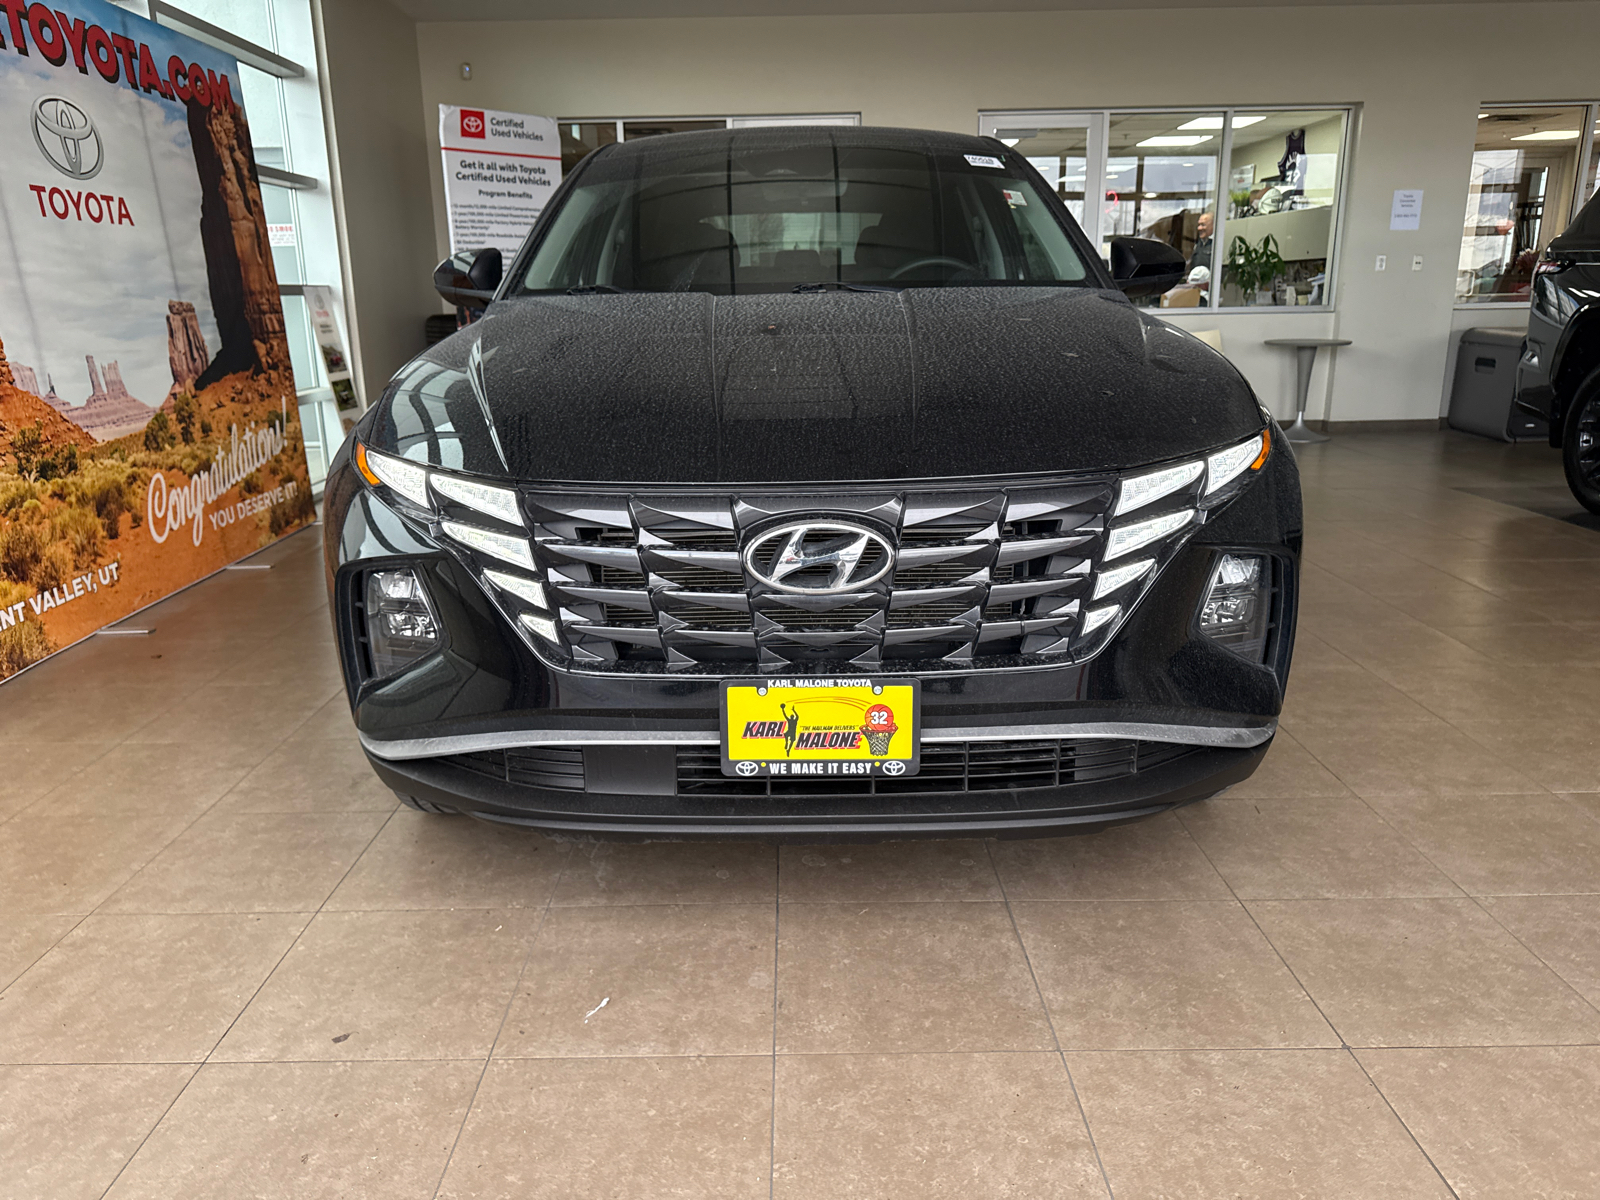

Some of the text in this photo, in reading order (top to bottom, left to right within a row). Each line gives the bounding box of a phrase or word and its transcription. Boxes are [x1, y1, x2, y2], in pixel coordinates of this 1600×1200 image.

[0, 0, 236, 115] TOYOTA.COM
[490, 117, 525, 129] Certified
[491, 128, 544, 142] Used Vehicles
[460, 159, 546, 177] Get it all with Toyota
[455, 172, 551, 187] Certified Used Vehicles
[478, 189, 533, 200] Program Benefits
[28, 183, 135, 227] TOYOTA
[147, 395, 288, 547] Congratulations!
[208, 481, 299, 531] YOU DESERVE IT!
[28, 572, 98, 616] VALLEY,
[97, 561, 119, 586] UT
[767, 679, 872, 688] KARL MALONE TOYOTA
[870, 711, 888, 725] 32
[742, 721, 786, 739] KARL
[795, 731, 862, 750] MALONE
[769, 762, 872, 774] WE MAKE IT EASY
